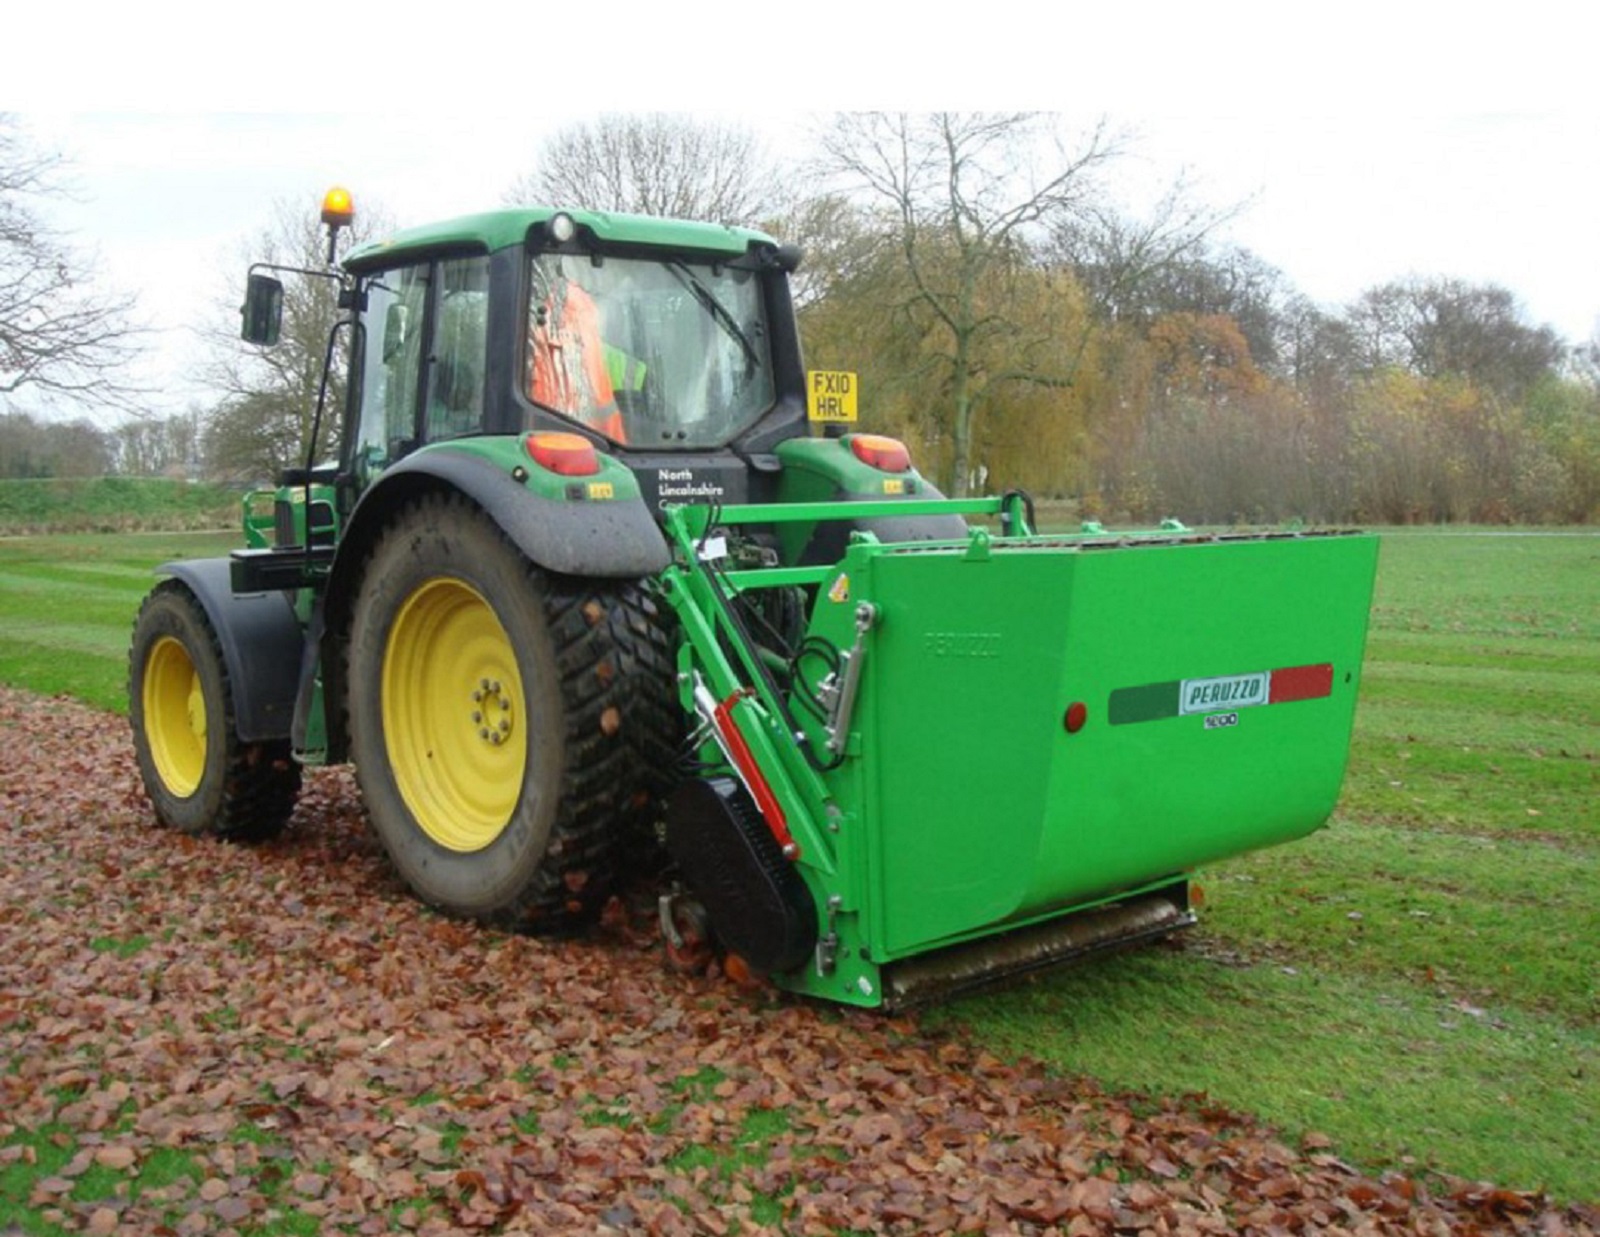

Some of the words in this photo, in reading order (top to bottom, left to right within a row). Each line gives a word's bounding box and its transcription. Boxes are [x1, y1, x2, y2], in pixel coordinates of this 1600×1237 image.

[813, 373, 850, 394] FX10
[816, 397, 848, 417] HRL
[658, 468, 693, 481] North
[658, 482, 724, 496] Lincolnshire
[1189, 679, 1261, 705] PERUZZO
